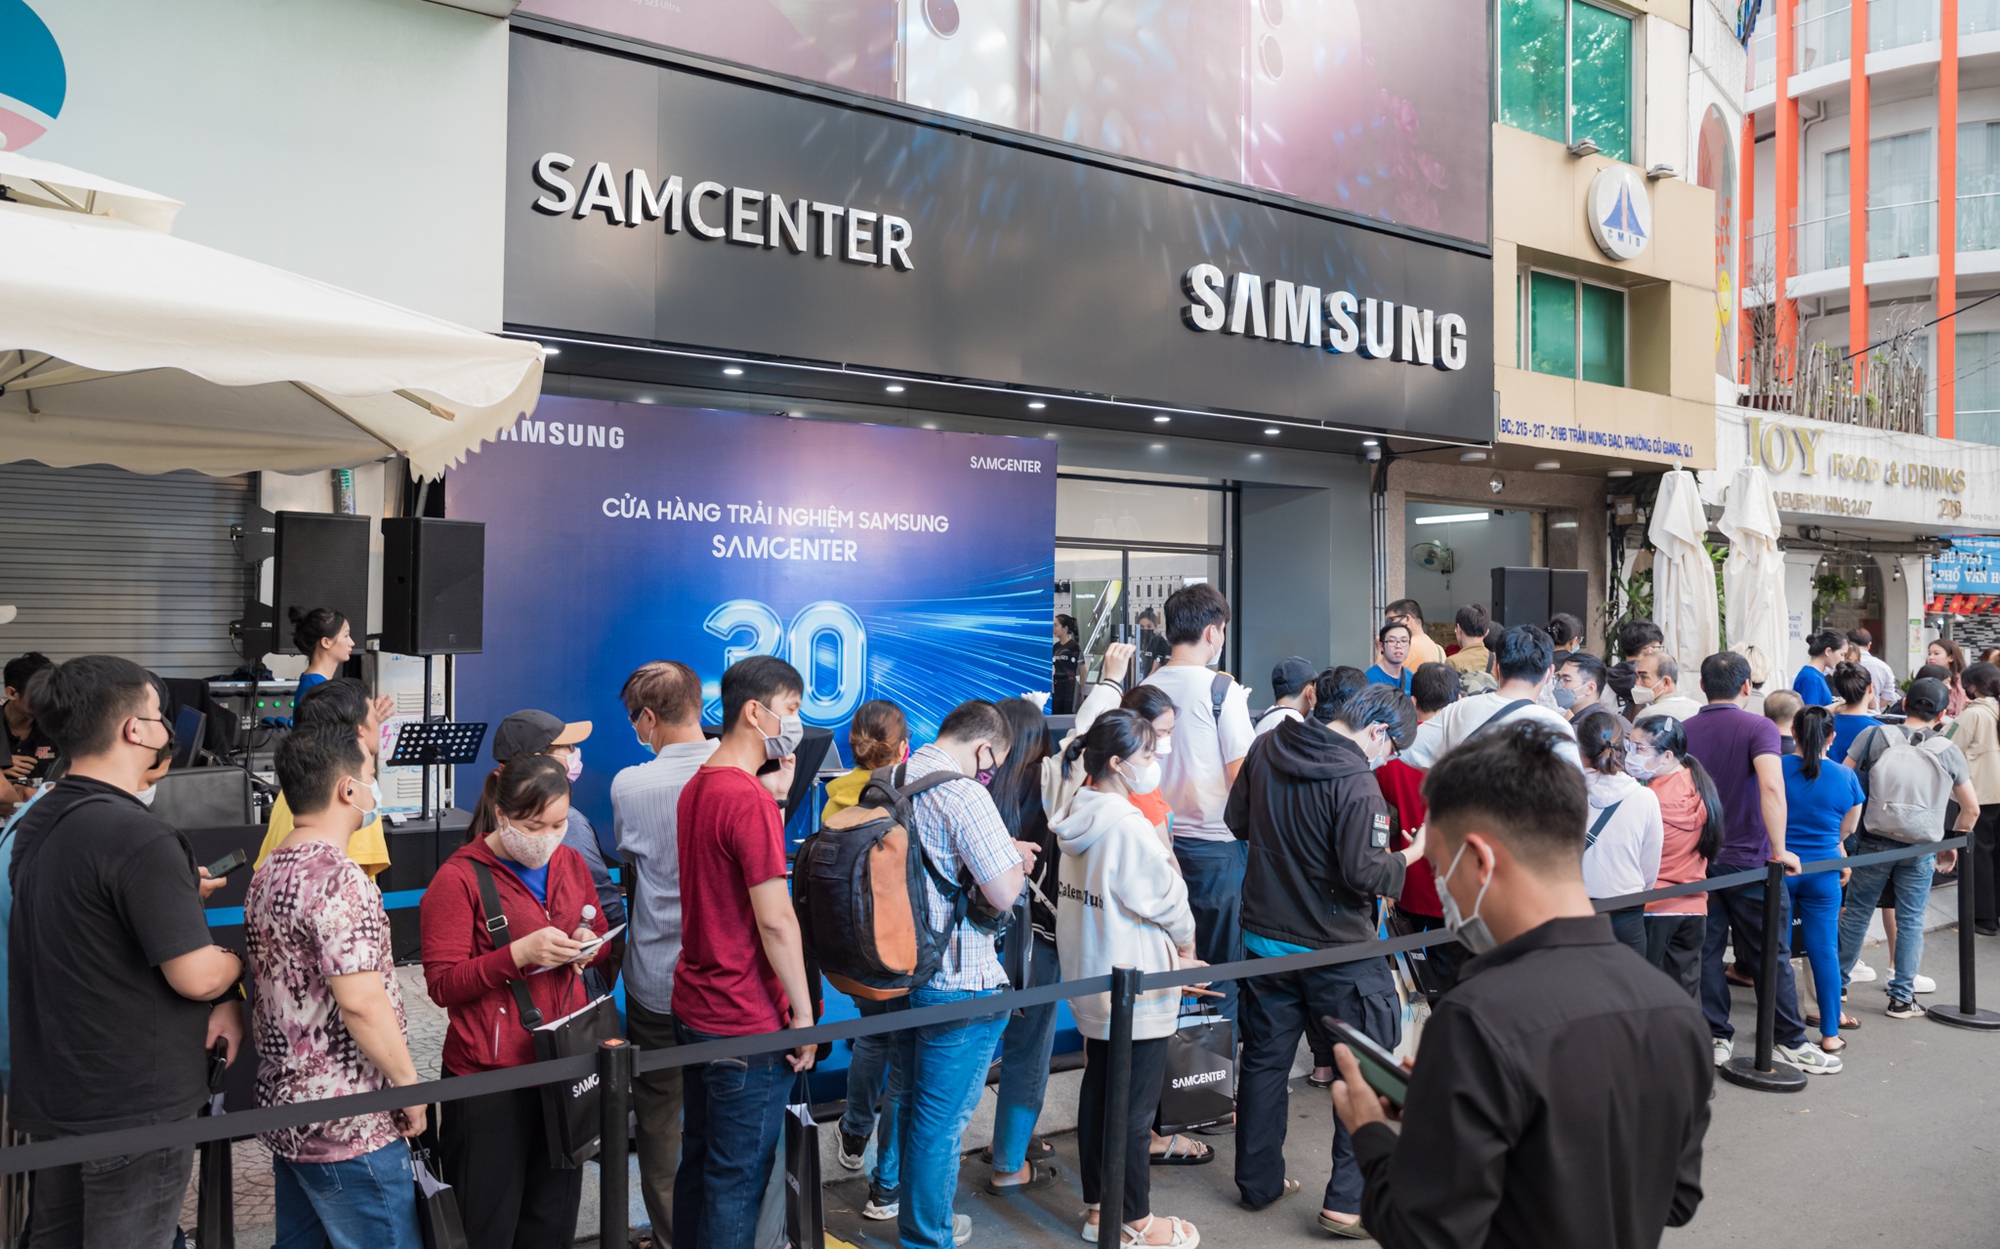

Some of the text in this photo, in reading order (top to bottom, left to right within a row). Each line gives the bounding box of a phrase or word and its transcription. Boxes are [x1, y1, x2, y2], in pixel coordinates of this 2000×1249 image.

[533, 152, 914, 271] SAMCENTER
[1185, 263, 1467, 371] SAMSUNG
[500, 420, 625, 449] AMSUNG
[1515, 421, 1528, 436] 215
[1533, 424, 1545, 438] 217
[970, 455, 1042, 474] SAMCENTER
[1747, 417, 1966, 493] JOY FOOD & DRINKS
[602, 492, 949, 533] CỬA HÀNG TRẢI NGHIỆM SAMSUNG
[1781, 491, 1850, 513] EVERYTHING
[1938, 497, 1962, 519] 219
[712, 534, 858, 562] SAMCENTER
[1083, 890, 1105, 911] lub
[1171, 1069, 1227, 1089] SAMCENTER
